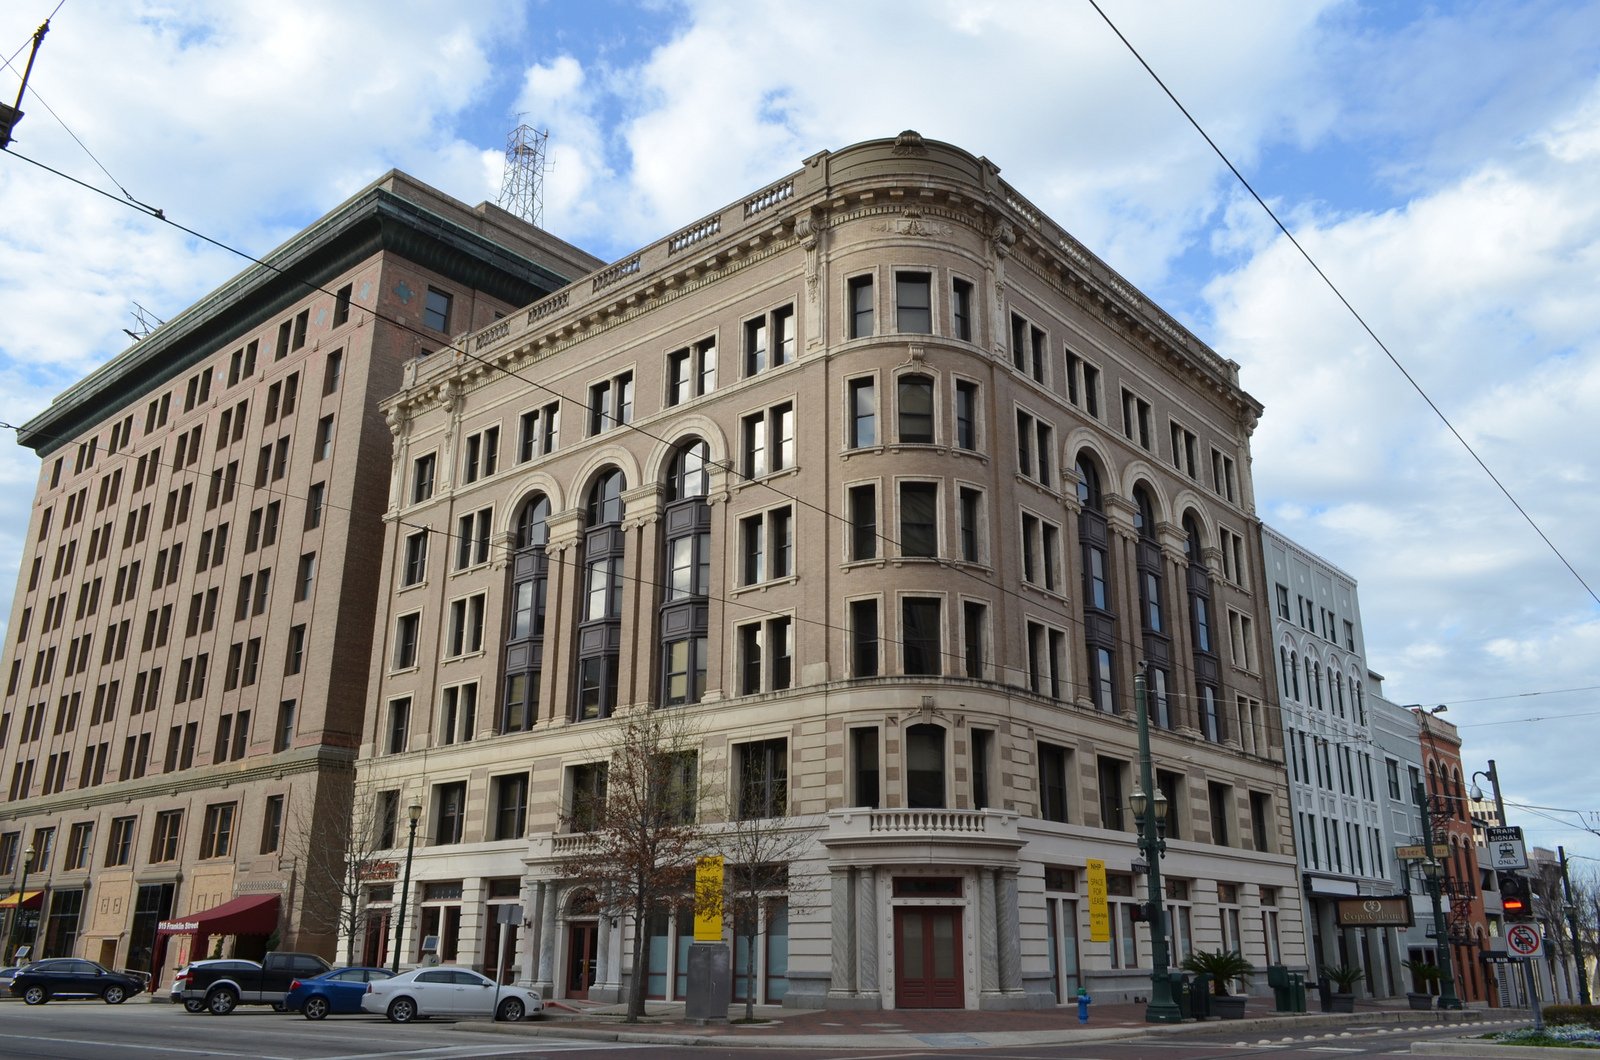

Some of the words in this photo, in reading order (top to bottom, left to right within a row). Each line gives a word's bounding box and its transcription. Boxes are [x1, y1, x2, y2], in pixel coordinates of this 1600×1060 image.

[1090, 878, 1104, 887] SPACE
[1093, 887, 1102, 896] FOR
[1091, 897, 1105, 905] LEASE
[158, 922, 167, 930] 915
[167, 922, 184, 930] Franklin
[184, 921, 199, 929] Street
